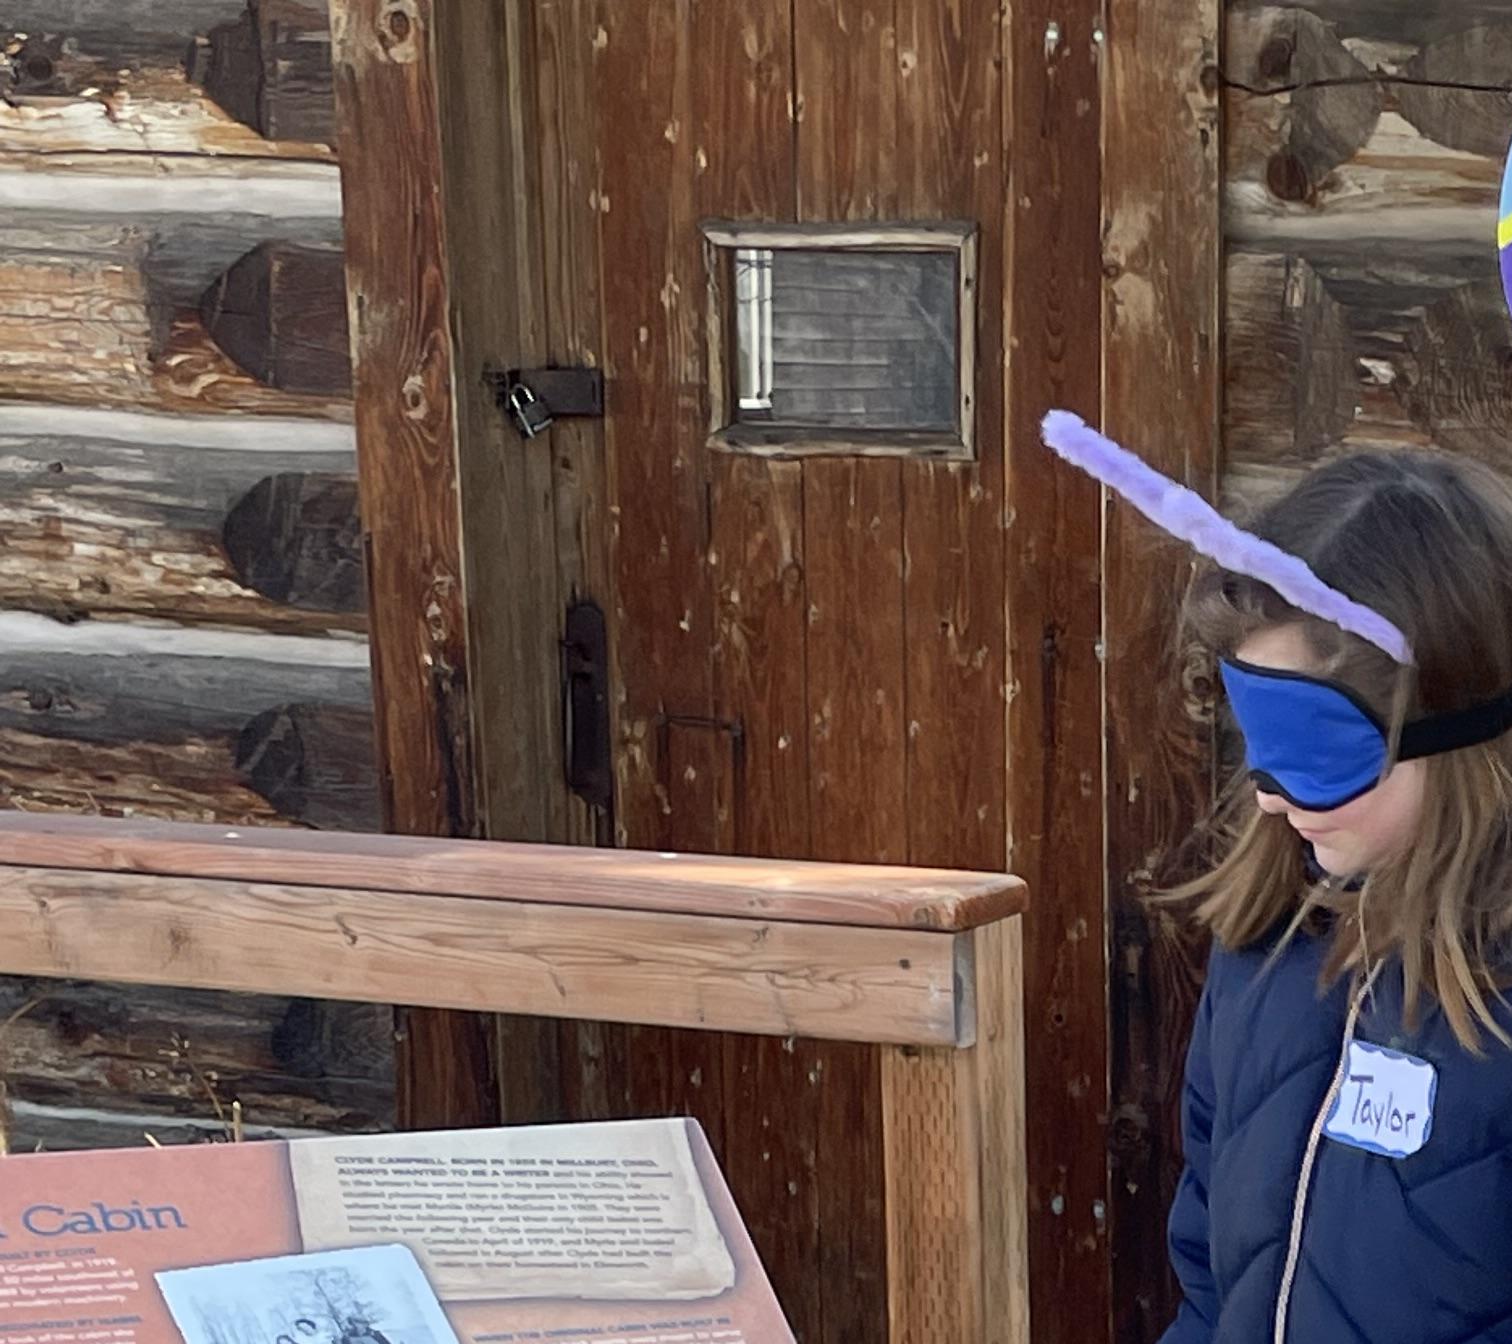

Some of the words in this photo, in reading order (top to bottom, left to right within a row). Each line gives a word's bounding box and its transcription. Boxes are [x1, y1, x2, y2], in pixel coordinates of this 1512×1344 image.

[1350, 1074, 1416, 1138] Taylor
[391, 1168, 447, 1176] WANTED
[451, 1169, 468, 1177] TO
[22, 1200, 188, 1236] Cabin
